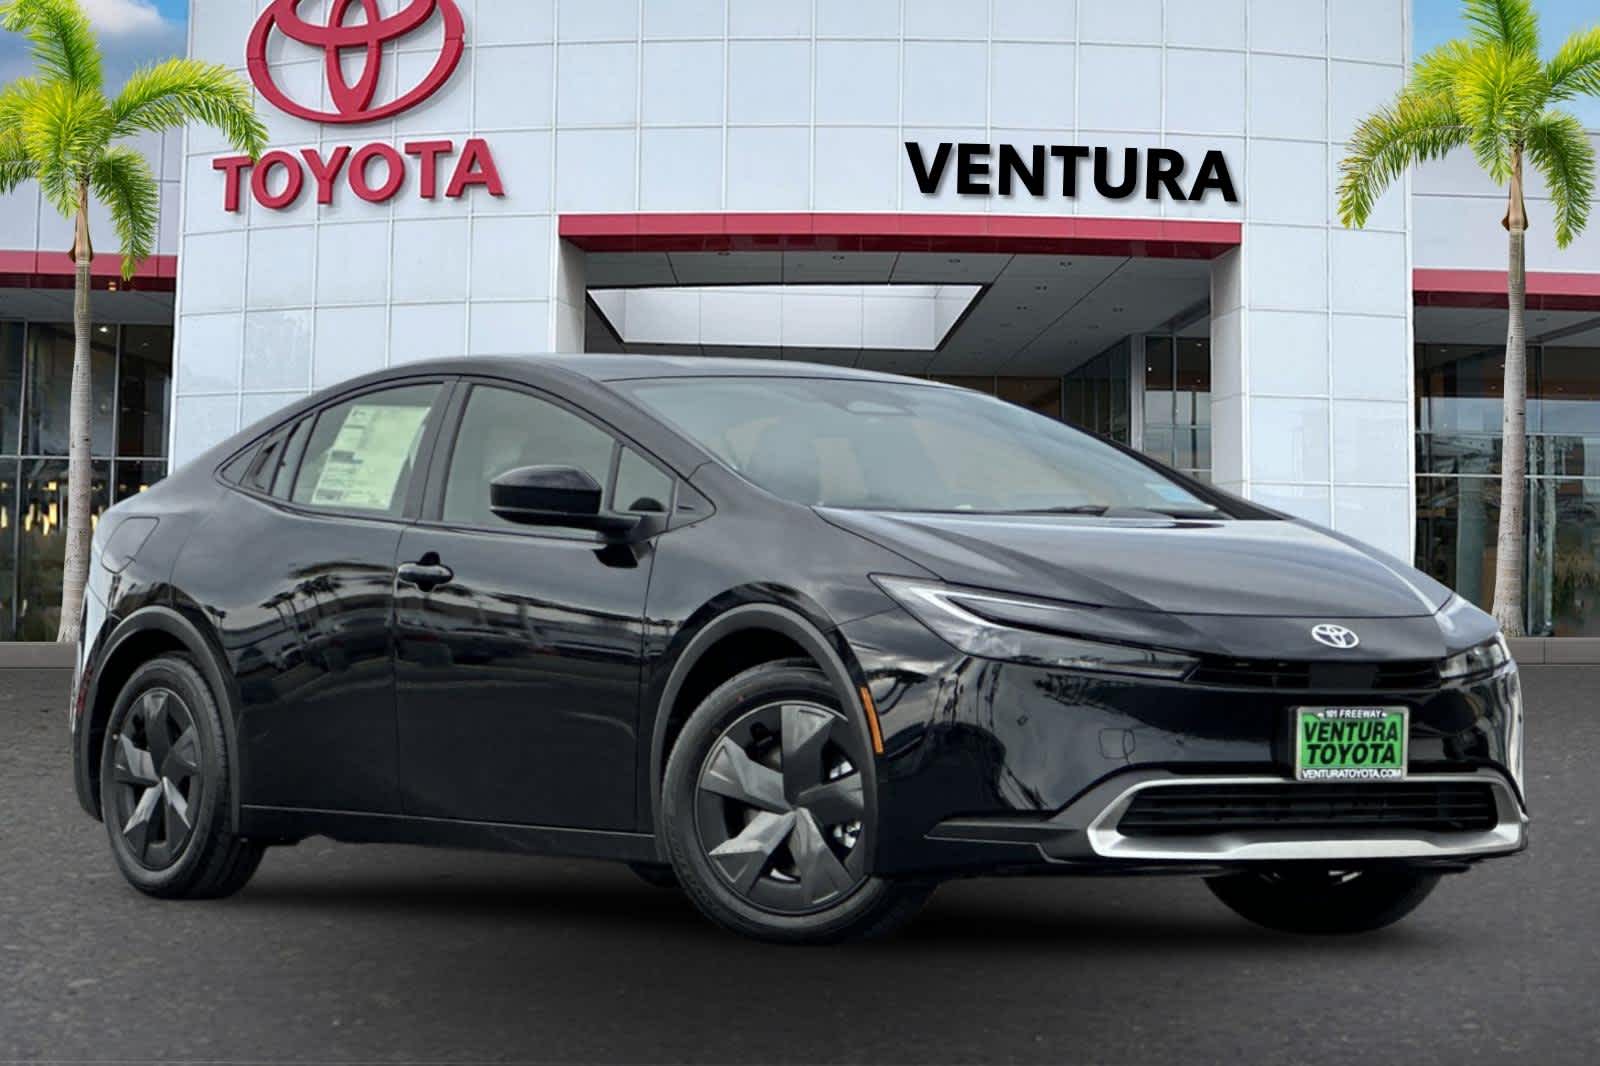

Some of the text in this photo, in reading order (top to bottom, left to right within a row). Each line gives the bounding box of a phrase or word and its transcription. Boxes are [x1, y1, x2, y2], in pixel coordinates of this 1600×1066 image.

[212, 138, 505, 212] TOYOTA
[904, 142, 1238, 203] VENTURA
[1326, 710, 1382, 718] 101 FREEWAY
[1304, 721, 1398, 742] VENTURA
[1307, 743, 1396, 764] TOYOTA
[1302, 768, 1401, 779] VENTURATOYOTA.COM
